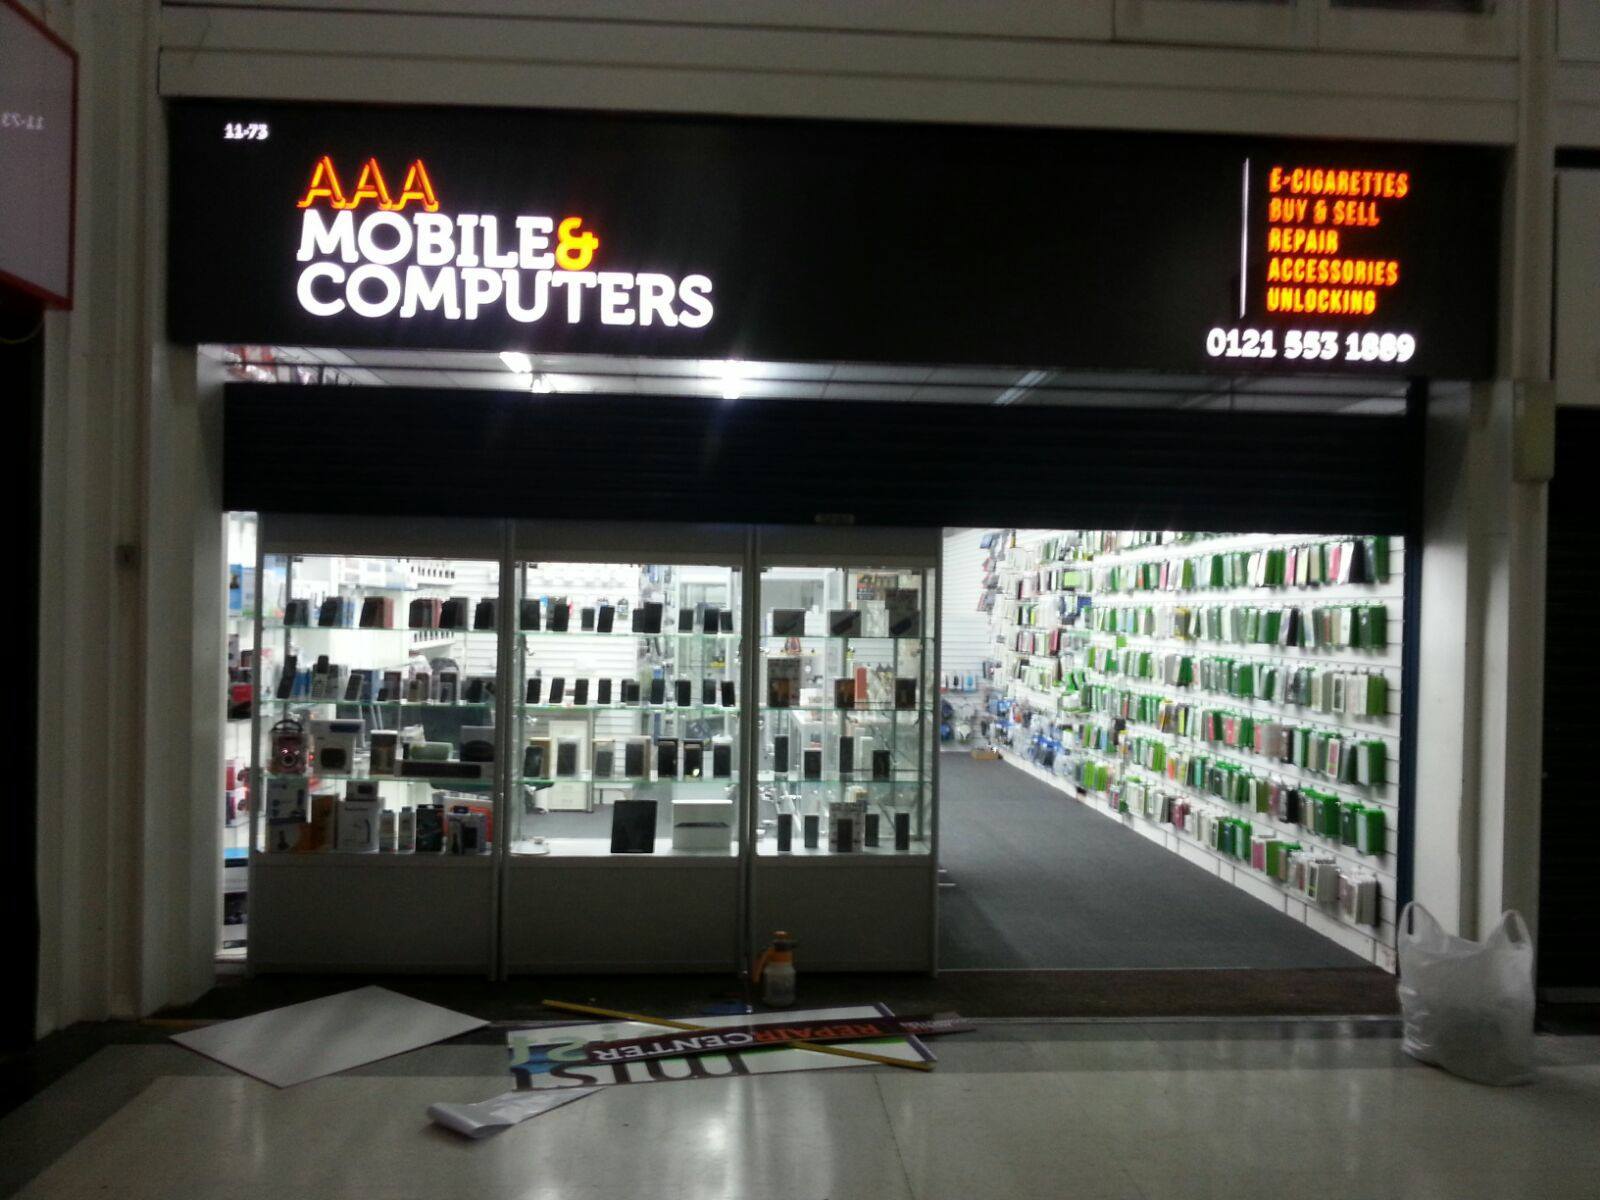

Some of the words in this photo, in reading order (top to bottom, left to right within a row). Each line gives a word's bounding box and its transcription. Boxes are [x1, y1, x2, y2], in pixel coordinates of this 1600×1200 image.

[223, 122, 269, 140] 11-73
[296, 155, 441, 213] AAA
[1269, 166, 1409, 198] E-CIGARETTES
[1269, 197, 1308, 223] BUY
[1313, 199, 1328, 225] &
[1332, 200, 1380, 226] SELL
[1268, 227, 1339, 255] REPAIR
[1267, 257, 1399, 286] ACCESSORIES
[296, 261, 714, 329] COMPUTERS
[1266, 286, 1377, 315] UNLOCKING
[1206, 327, 1278, 358] 0121
[1283, 329, 1340, 361] 553
